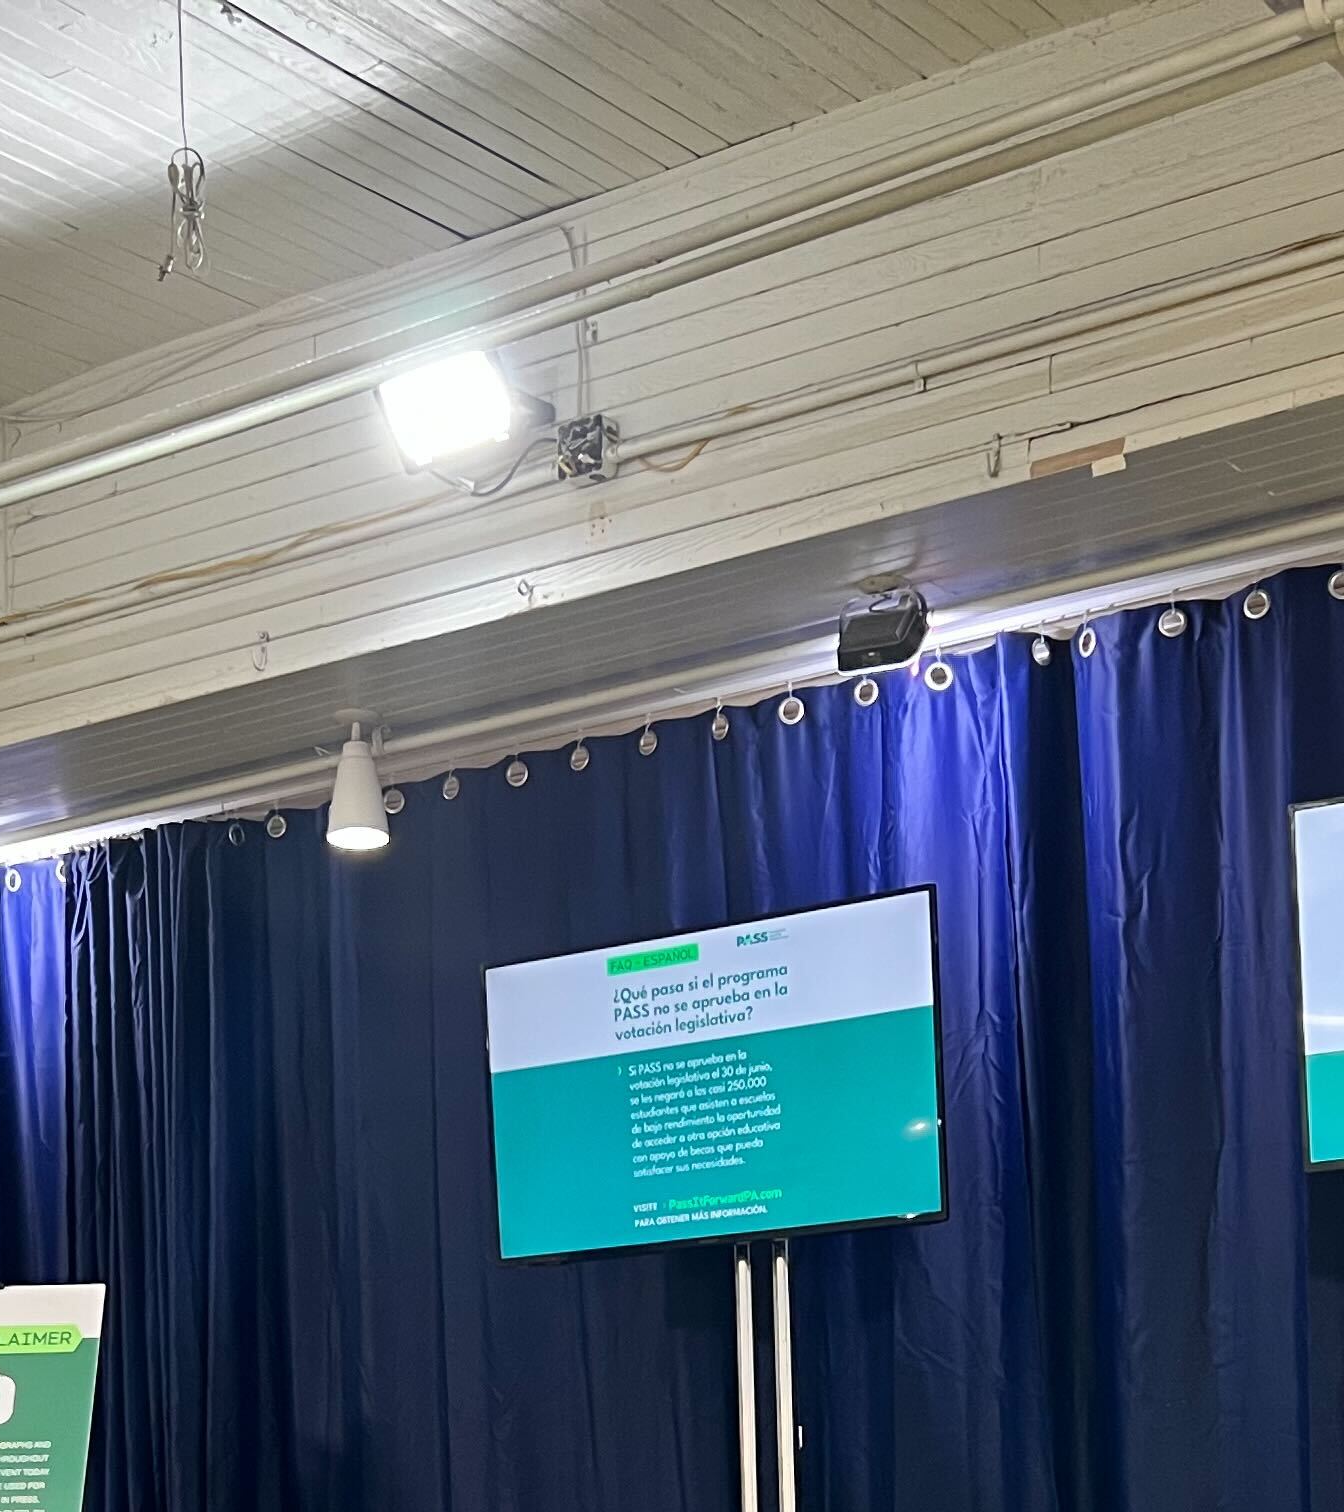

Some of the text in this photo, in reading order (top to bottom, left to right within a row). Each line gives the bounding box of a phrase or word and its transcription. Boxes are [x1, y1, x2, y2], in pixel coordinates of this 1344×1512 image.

[736, 931, 768, 947] PASS
[610, 959, 632, 972] FAQ
[643, 947, 695, 968] ESPAÑOL
[613, 966, 788, 1005] ¿Qué pasa si el programa
[614, 981, 788, 1022] PASS no se aprueba en la
[615, 1005, 754, 1041] votación legislativa?
[638, 1061, 661, 1075] PASS
[662, 1063, 674, 1072] no
[676, 1061, 685, 1069] se
[687, 1053, 724, 1069] aprueba
[725, 1053, 737, 1062] en
[738, 1049, 747, 1060] la
[629, 1077, 665, 1091] votación
[667, 1070, 710, 1087] legislativa
[711, 1068, 720, 1079] el
[721, 1065, 733, 1078] 30
[735, 1065, 747, 1075] de
[630, 1091, 776, 1120] estudiantes que asisten a escuelas
[641, 1093, 653, 1104] les
[686, 1089, 693, 1097] a
[694, 1085, 706, 1096] los
[631, 1104, 781, 1134] de bajo rendimiento la oportunidad
[632, 1121, 781, 1149] de acceder a otra opción educativa
[632, 1138, 764, 1164] con apoyo de becas que pueda
[675, 1163, 689, 1172] sus
[668, 1188, 783, 1210] PassItForwardPA.com
[634, 1216, 655, 1228] PARA
[656, 1213, 690, 1225] OBTENER
[691, 1210, 709, 1221] MÁS
[27, 1481, 46, 1490] FOR
